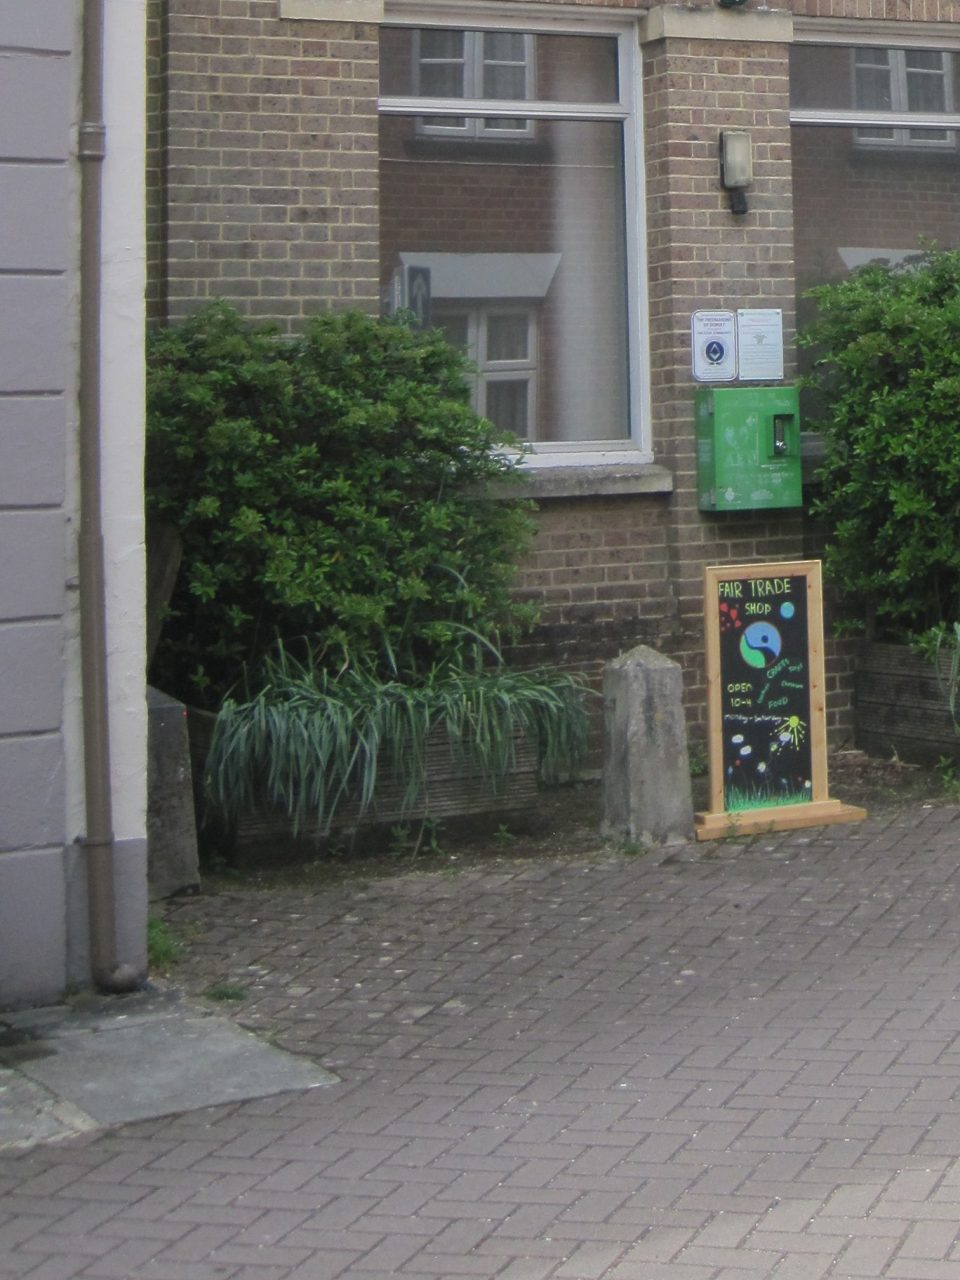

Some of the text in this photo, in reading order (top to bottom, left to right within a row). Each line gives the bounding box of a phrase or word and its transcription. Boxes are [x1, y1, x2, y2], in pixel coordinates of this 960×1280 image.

[718, 578, 792, 598] FAIR TRADE
[745, 602, 772, 615] SHOP
[727, 682, 752, 693] OPEN
